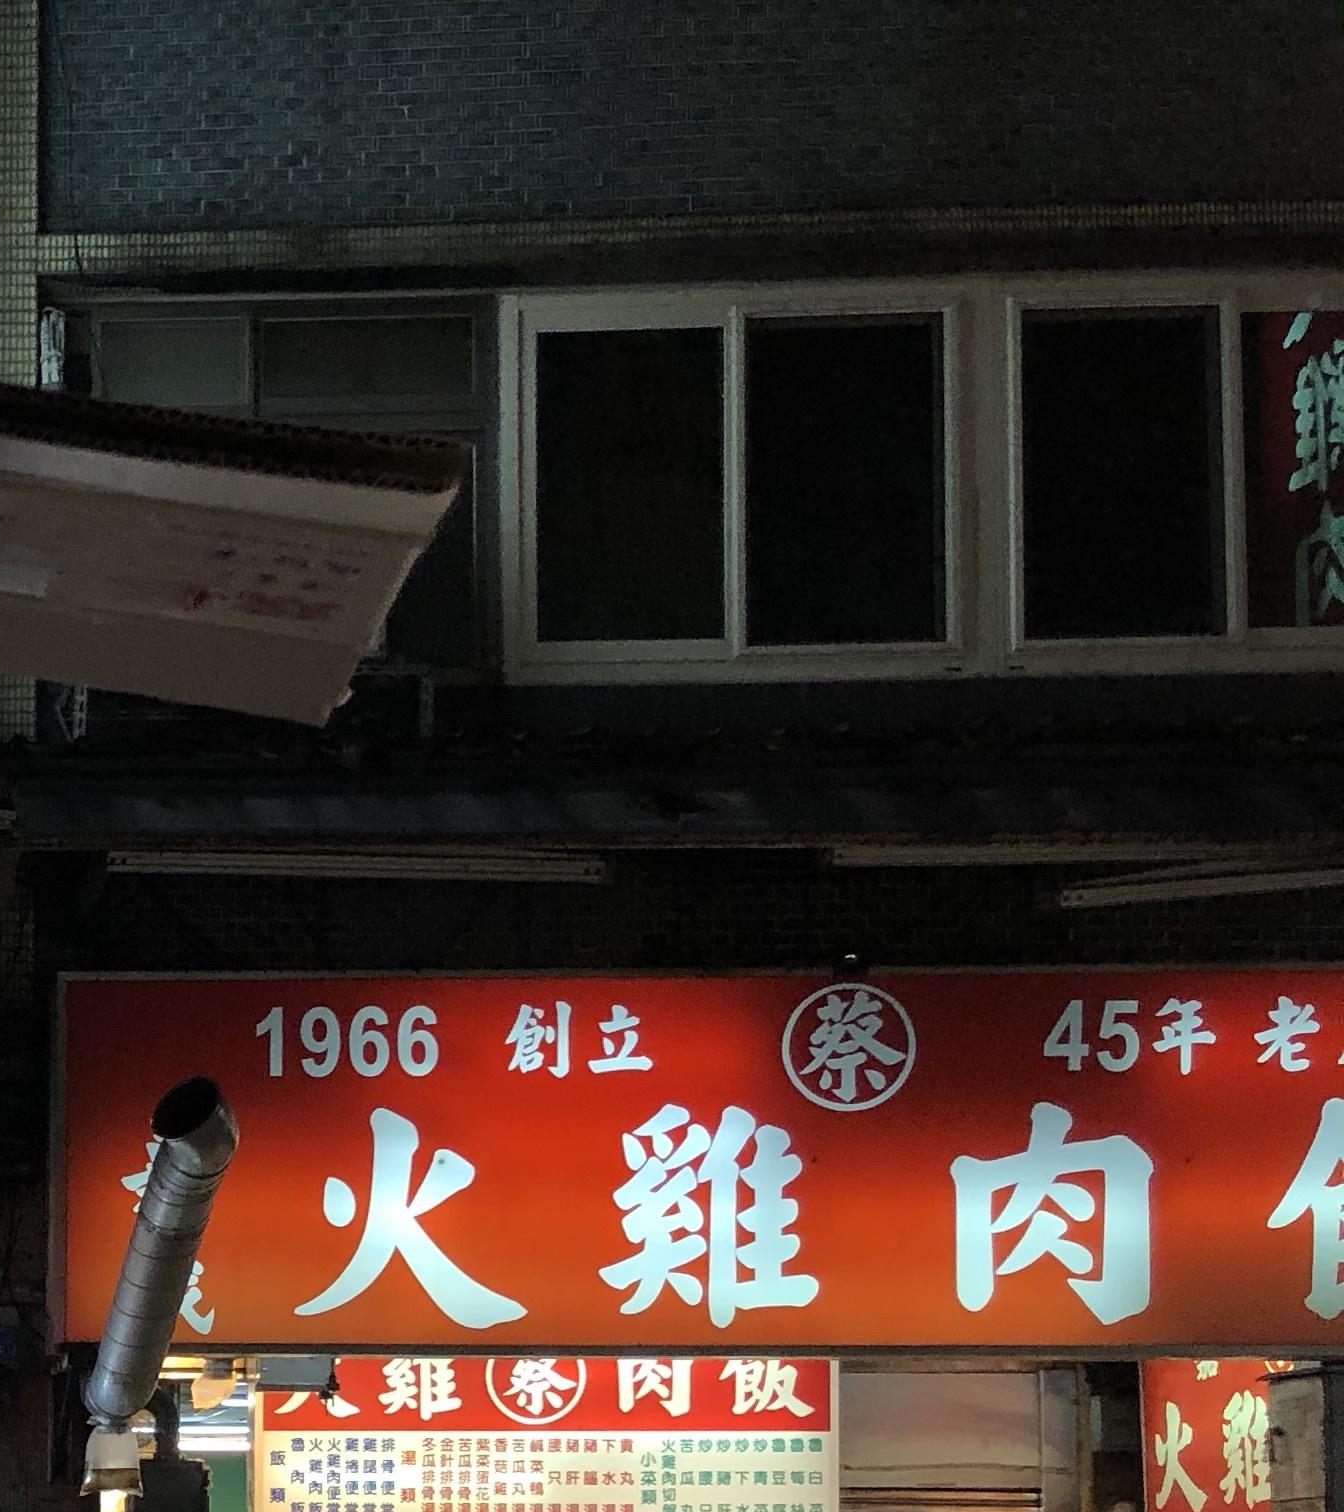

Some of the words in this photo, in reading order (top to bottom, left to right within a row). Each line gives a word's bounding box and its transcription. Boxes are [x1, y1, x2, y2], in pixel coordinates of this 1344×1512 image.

[255, 1003, 440, 1079] 1966
[505, 1003, 654, 1079] 創立
[801, 989, 905, 1101] 蔡
[1043, 995, 1344, 1076] 45年老
